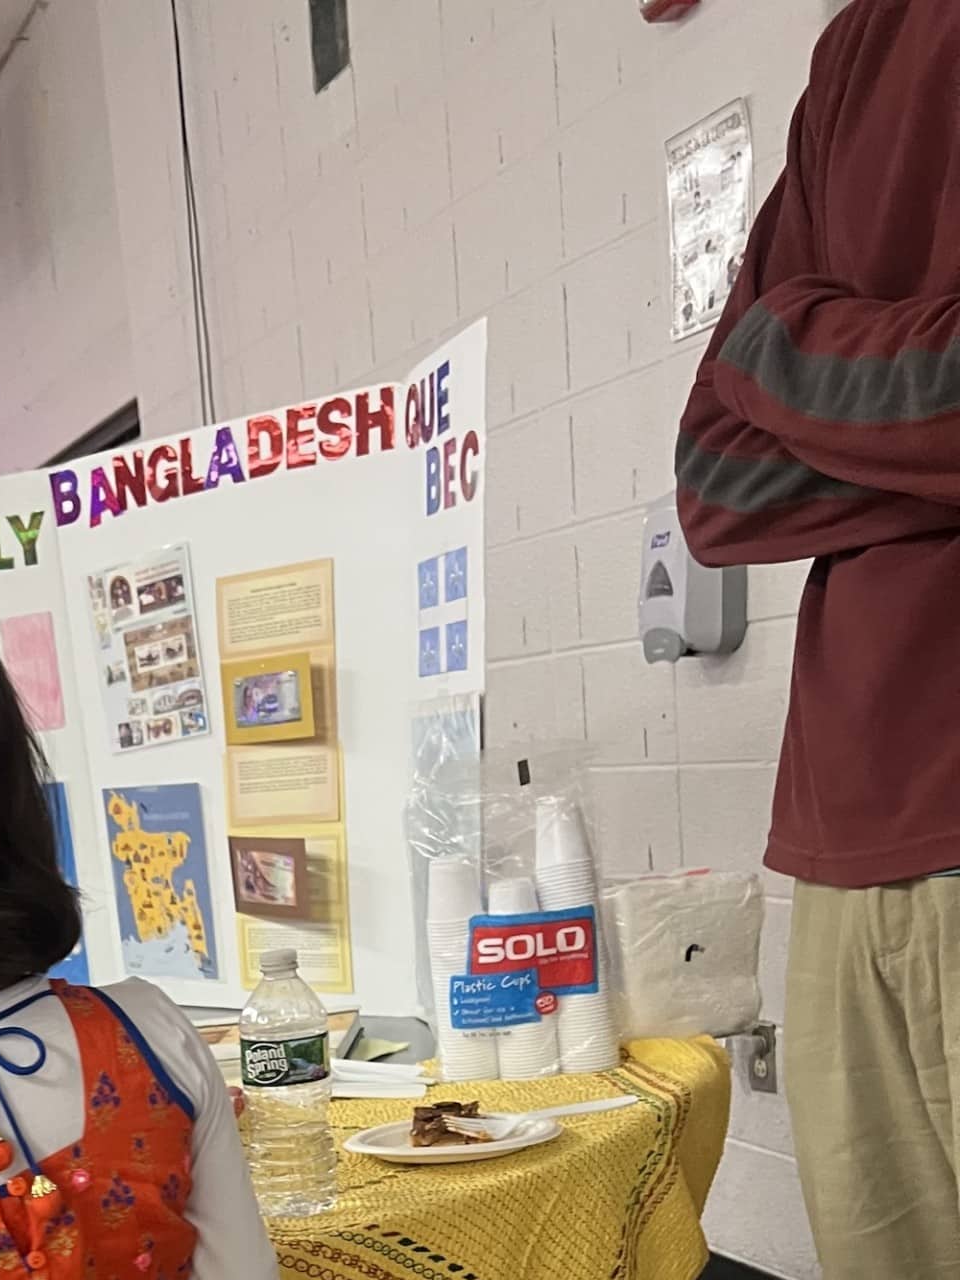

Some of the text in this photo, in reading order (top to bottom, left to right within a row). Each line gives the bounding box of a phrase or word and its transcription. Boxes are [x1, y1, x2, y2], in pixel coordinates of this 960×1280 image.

[405, 360, 450, 450] QUE
[49, 387, 395, 528] BANGLADESH
[426, 430, 480, 516] BEC
[477, 926, 586, 964] SOLO
[453, 974, 532, 994] Plastic Cups
[244, 1043, 286, 1065] Poland
[247, 1058, 289, 1079] Spring
